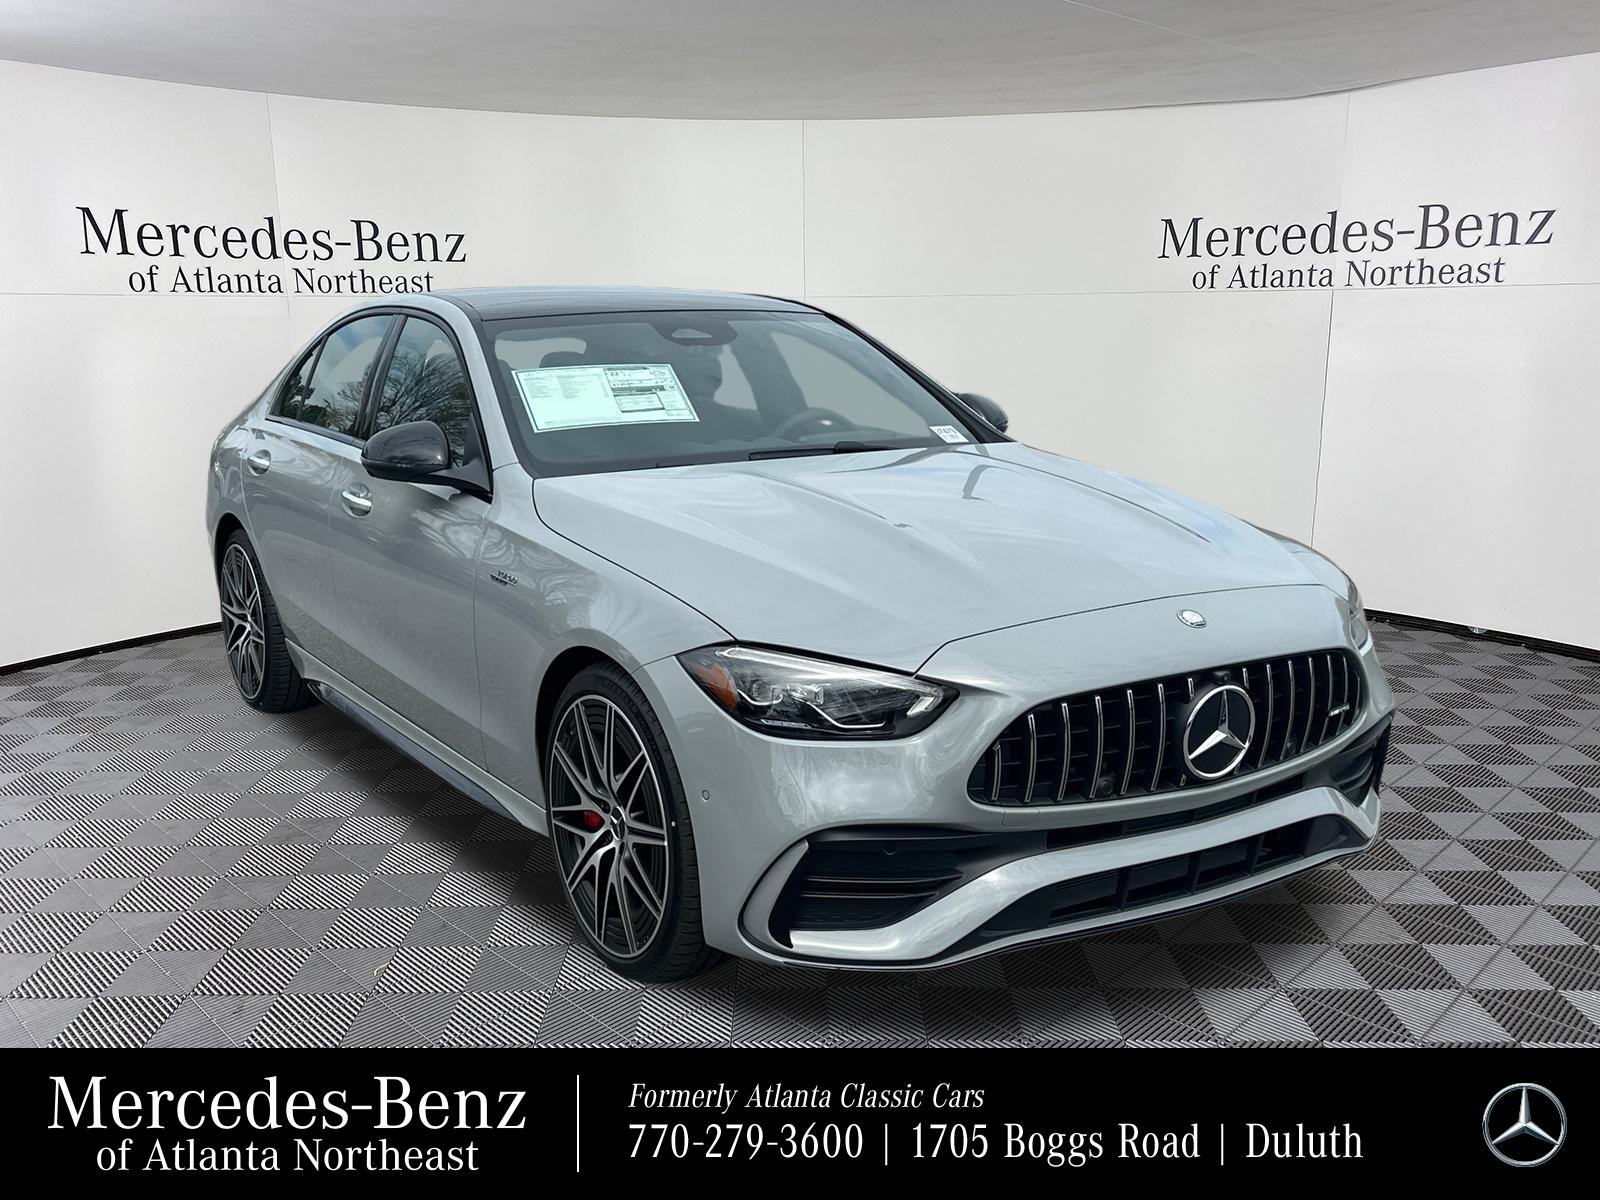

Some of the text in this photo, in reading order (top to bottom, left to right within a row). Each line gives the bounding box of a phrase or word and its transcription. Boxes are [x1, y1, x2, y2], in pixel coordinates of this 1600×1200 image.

[75, 206, 467, 263] Mercedes-Benz
[1157, 204, 1557, 259] Mercedes-Benz
[128, 264, 434, 294] of Atlanta Northeast
[1192, 257, 1506, 290] of Atlanta Northeast
